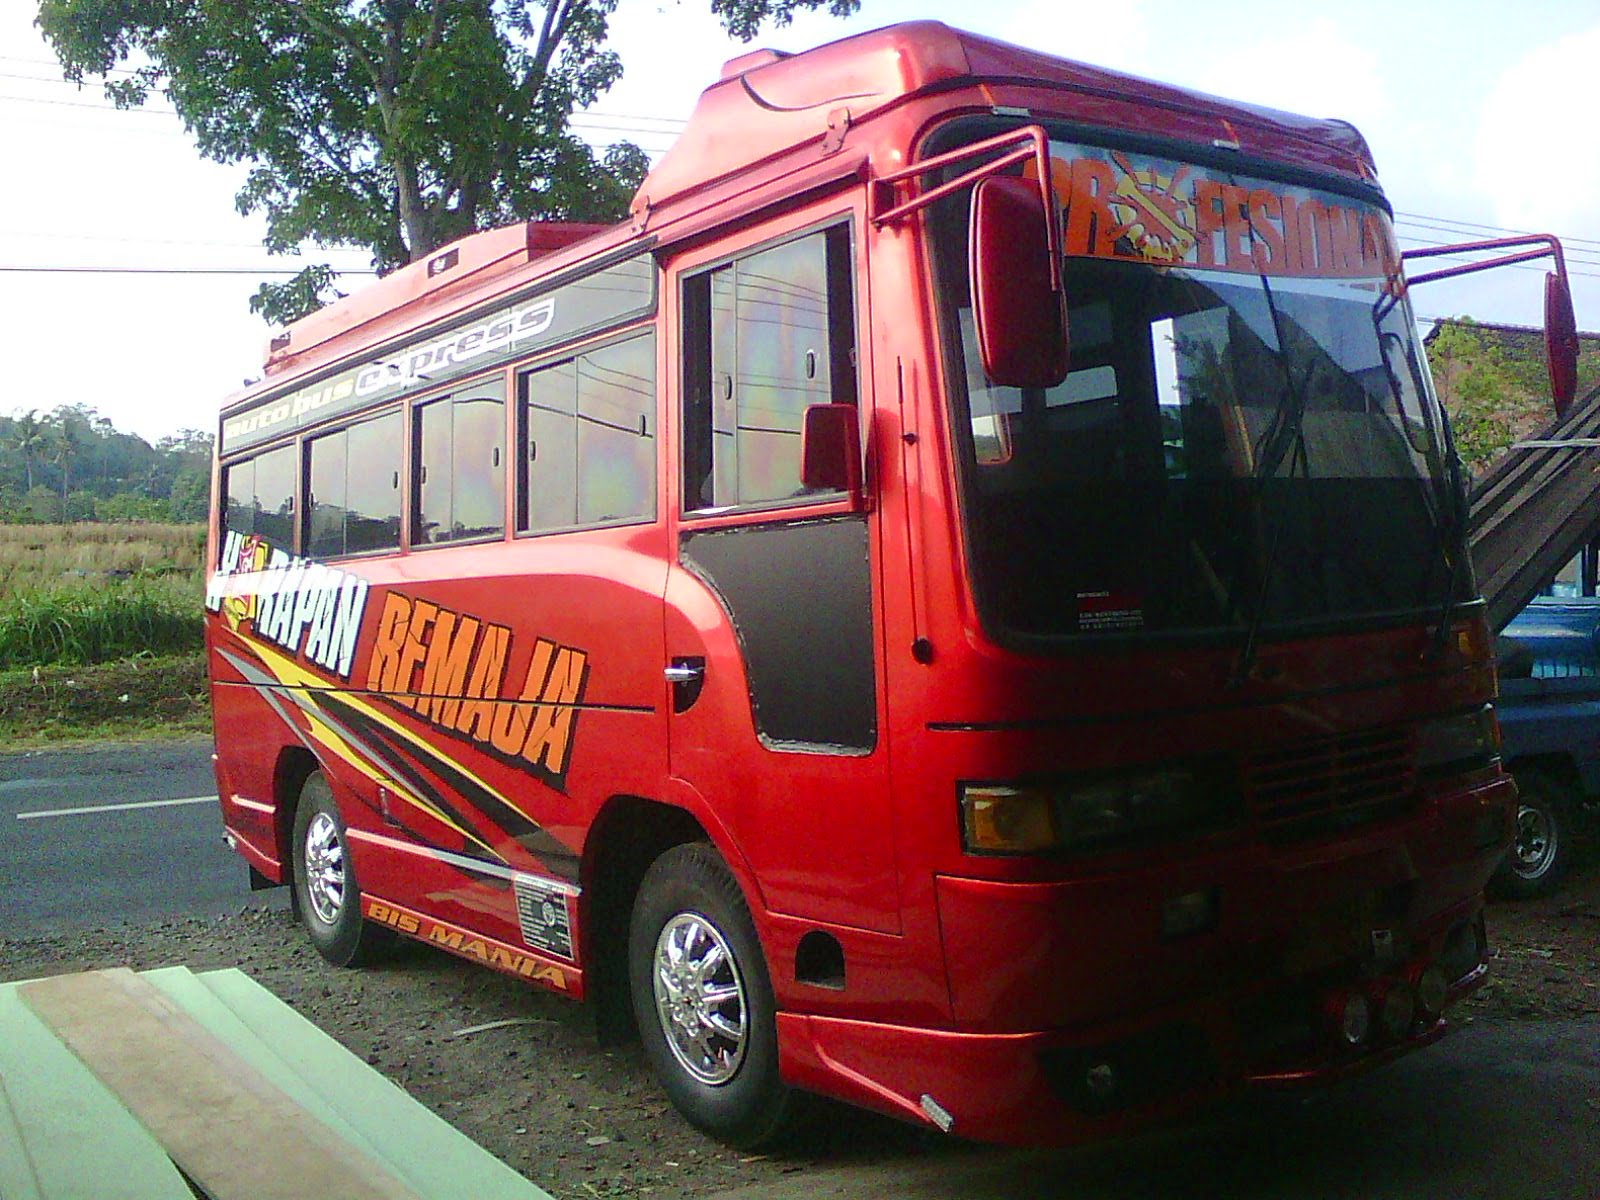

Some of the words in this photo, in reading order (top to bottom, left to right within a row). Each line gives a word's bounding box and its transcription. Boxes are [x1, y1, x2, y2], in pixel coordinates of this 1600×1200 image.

[1023, 153, 1396, 278] PROFESIONA
[355, 297, 555, 398] express
[367, 591, 588, 776] REMAJA
[367, 902, 420, 934] BIS
[428, 925, 568, 990] MANIA
